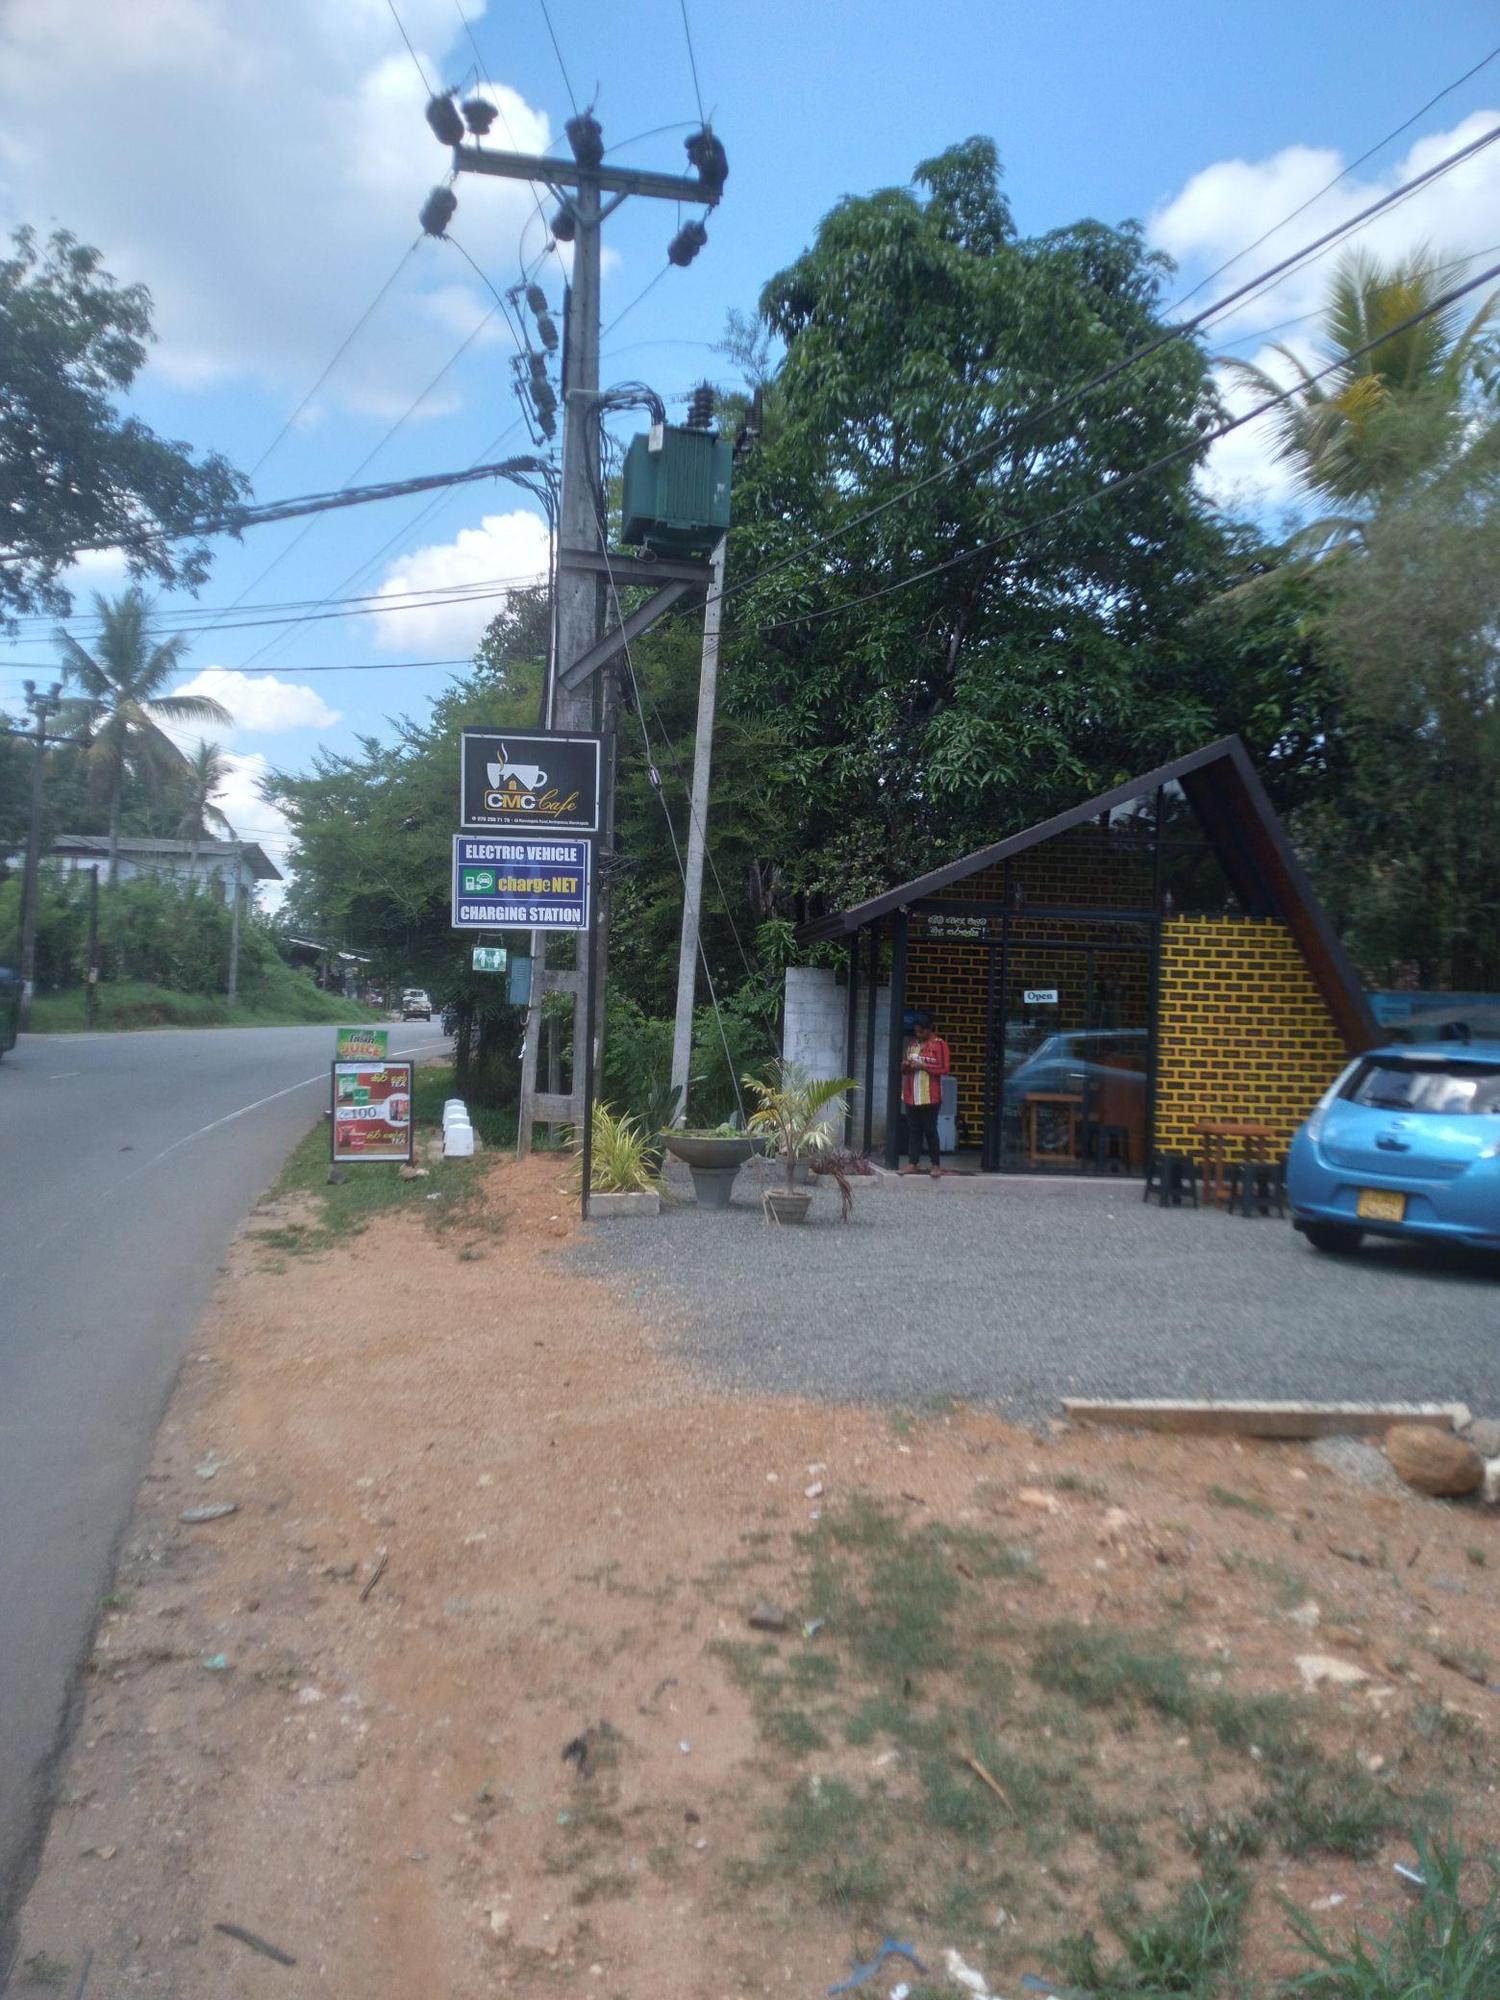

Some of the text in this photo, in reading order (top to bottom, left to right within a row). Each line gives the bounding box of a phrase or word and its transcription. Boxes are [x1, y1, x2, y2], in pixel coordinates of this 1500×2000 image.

[487, 788, 579, 818] CMC Cafe
[465, 844, 577, 862] ELECTRIC VEHICLE
[460, 905, 581, 922] CHARGING STATION
[1027, 991, 1054, 1001] Open
[352, 1107, 377, 1119] 100
